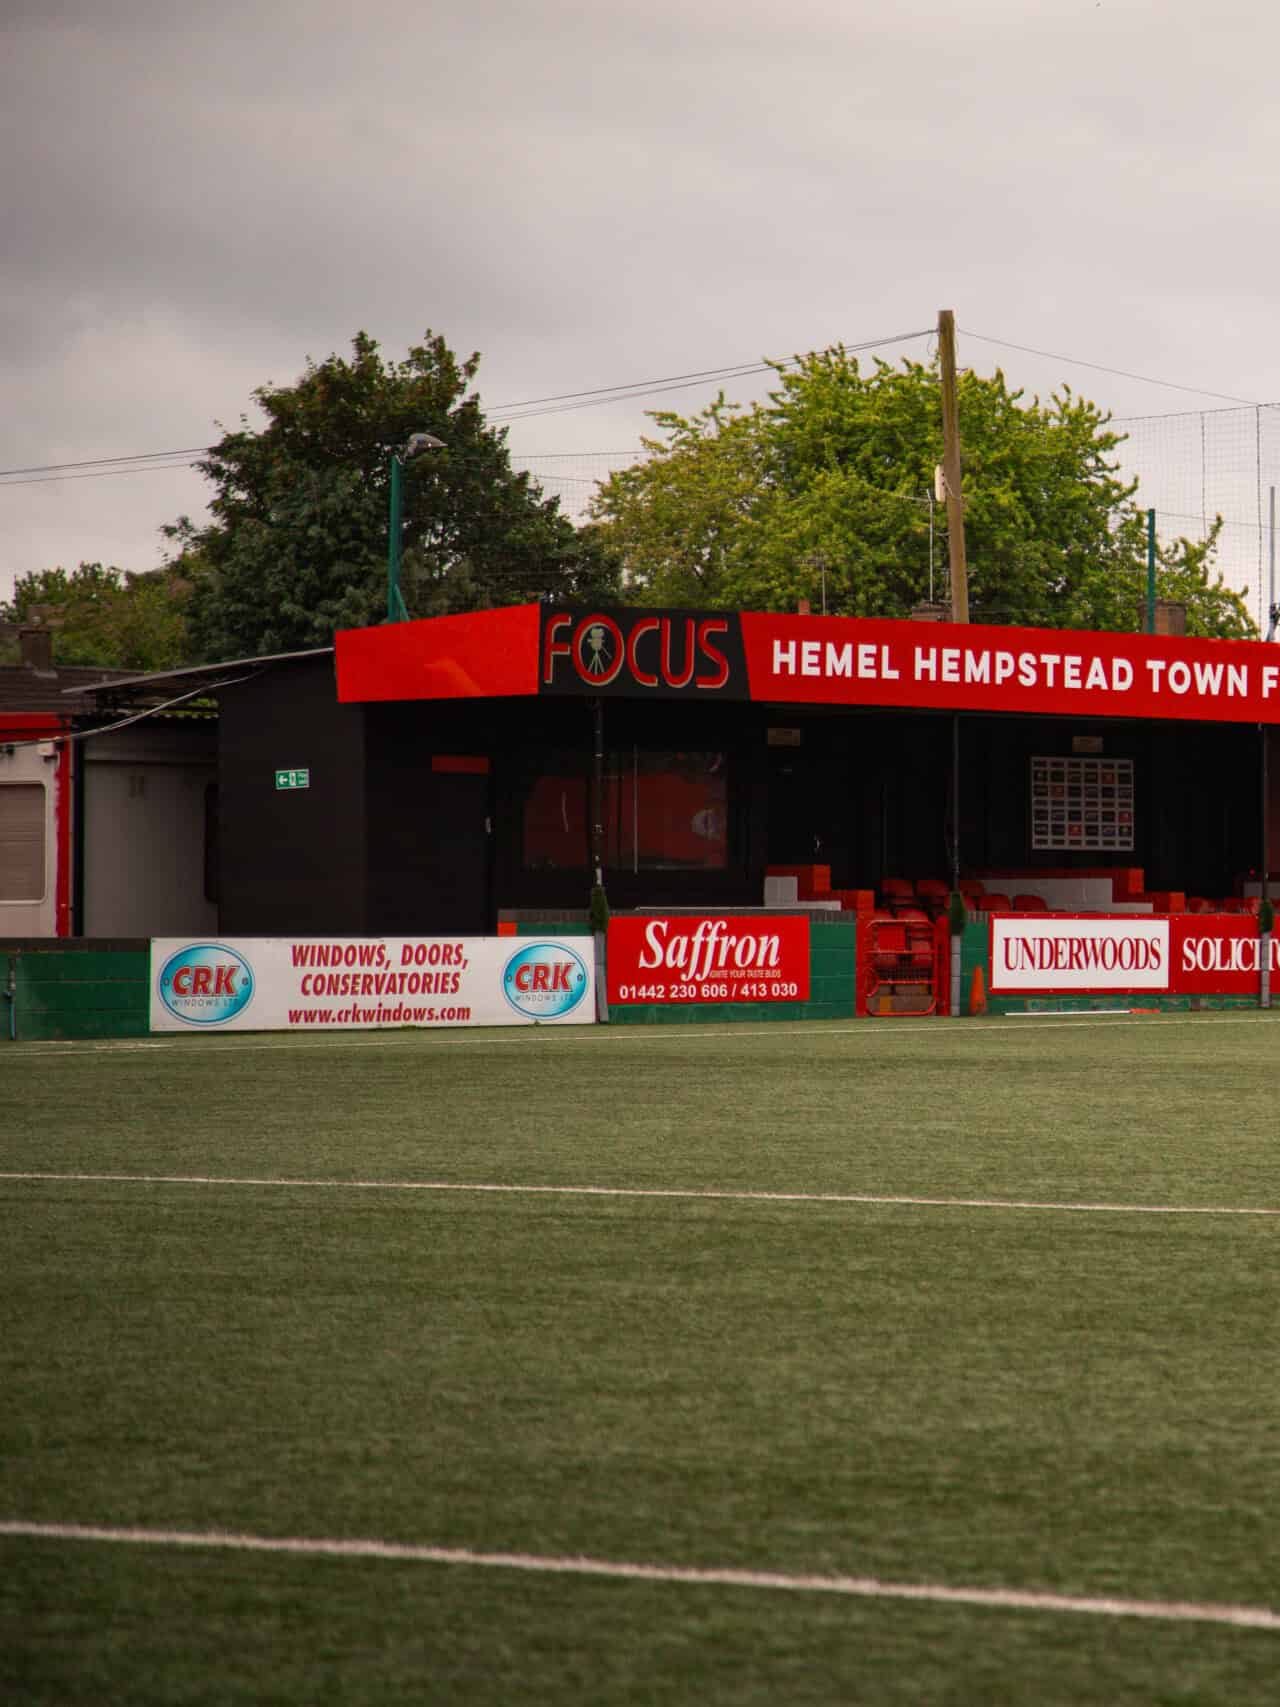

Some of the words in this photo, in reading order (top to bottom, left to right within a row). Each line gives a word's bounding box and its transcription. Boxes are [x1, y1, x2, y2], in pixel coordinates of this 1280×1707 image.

[544, 614, 729, 689] FOCUS
[772, 640, 899, 680] HEMEL
[914, 647, 1134, 692] HEMPSTEAD
[1146, 660, 1248, 697] TOWN
[291, 944, 391, 970] WINDOWS,
[400, 943, 469, 970] DOORS,
[638, 920, 780, 982] Saffron
[1003, 937, 1161, 970] UNDERWOODS
[172, 965, 240, 996] CRK
[301, 971, 461, 997] CONSERVATORIES
[515, 962, 575, 993] CRK
[619, 985, 665, 999] 01442
[670, 984, 696, 998] 230
[701, 984, 728, 998] 606
[740, 983, 767, 997] 413
[771, 983, 797, 997] 030
[288, 1001, 471, 1024] www.crkwindows.com
